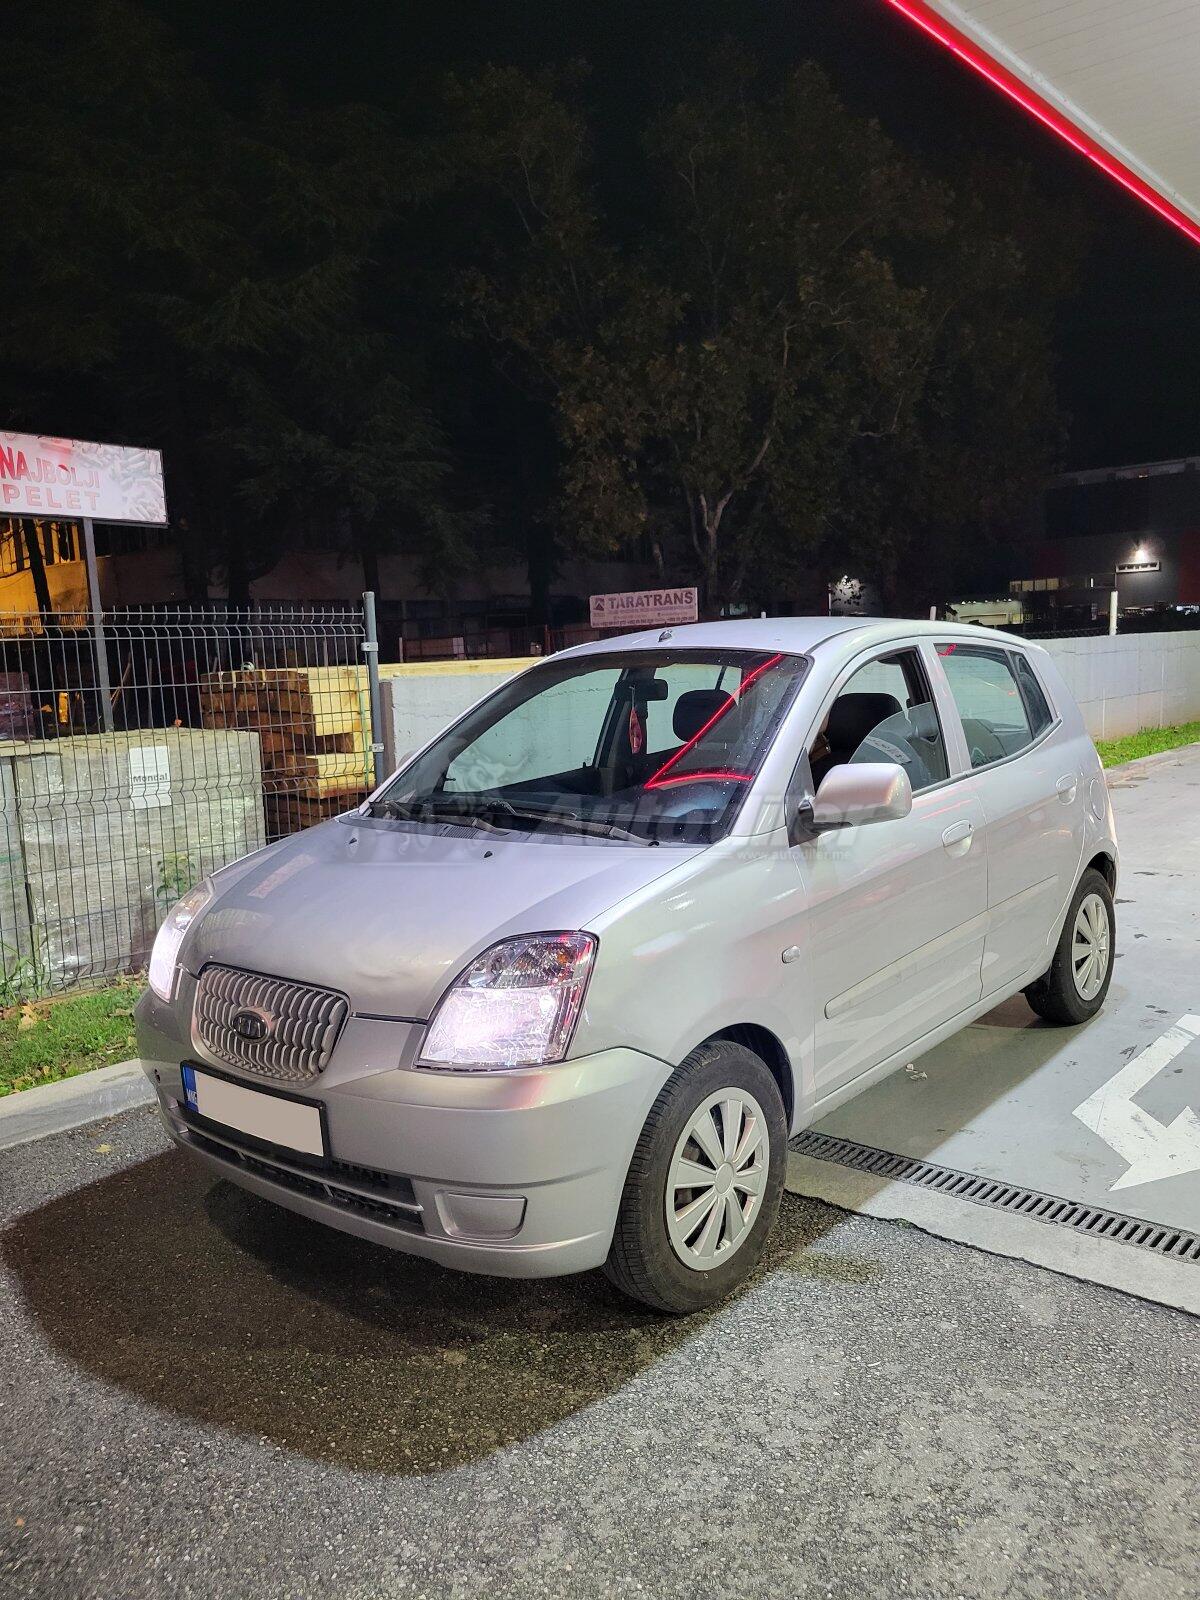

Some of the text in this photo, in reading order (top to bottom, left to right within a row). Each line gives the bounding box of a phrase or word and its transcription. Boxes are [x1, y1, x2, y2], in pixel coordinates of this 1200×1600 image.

[0, 444, 99, 488] NAJBOLJI
[3, 484, 99, 511] PELET
[608, 591, 693, 609] TARATRANS
